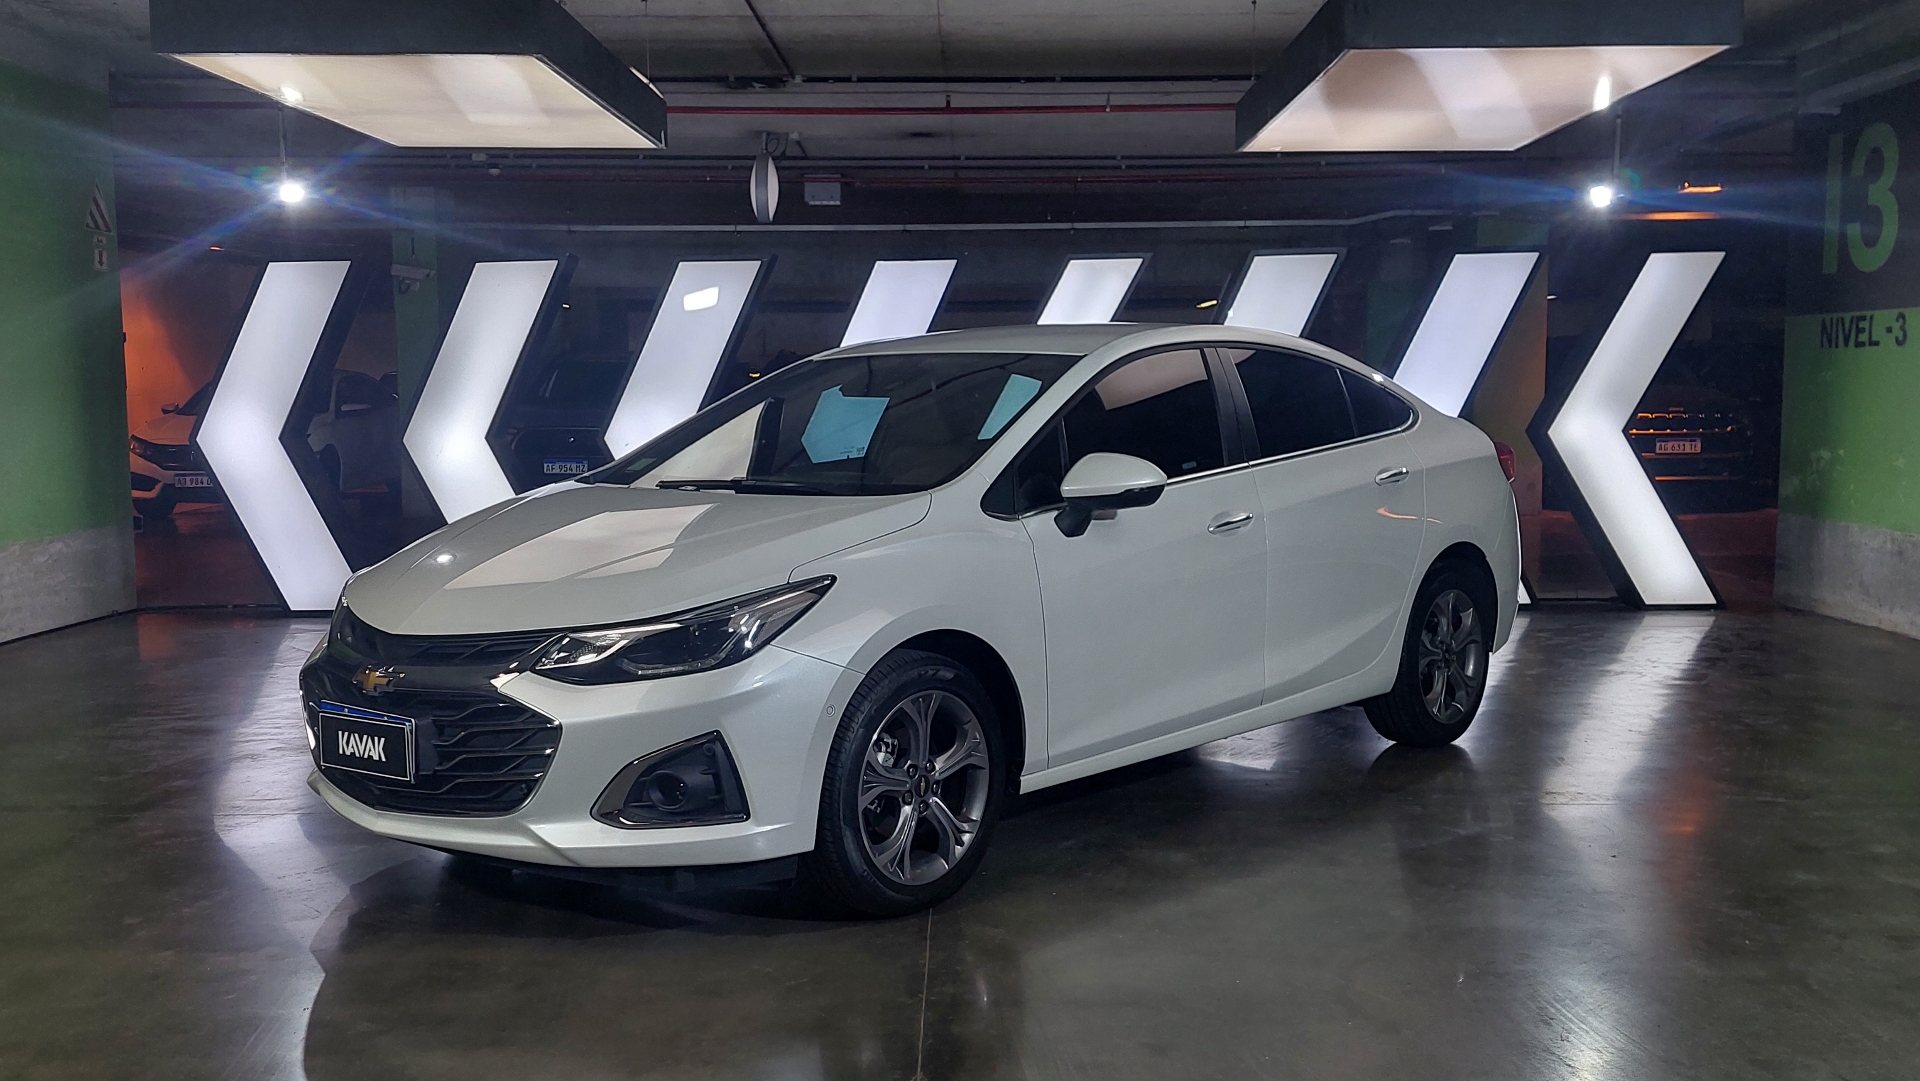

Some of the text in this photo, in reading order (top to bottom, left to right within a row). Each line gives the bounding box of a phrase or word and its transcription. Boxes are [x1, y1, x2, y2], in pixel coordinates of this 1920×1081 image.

[1822, 121, 1900, 275] 13
[1820, 314, 1881, 349] NIVEL
[189, 477, 204, 486] 984
[545, 464, 556, 473] AF
[558, 464, 574, 473] 954
[338, 730, 387, 762] KAVAK
